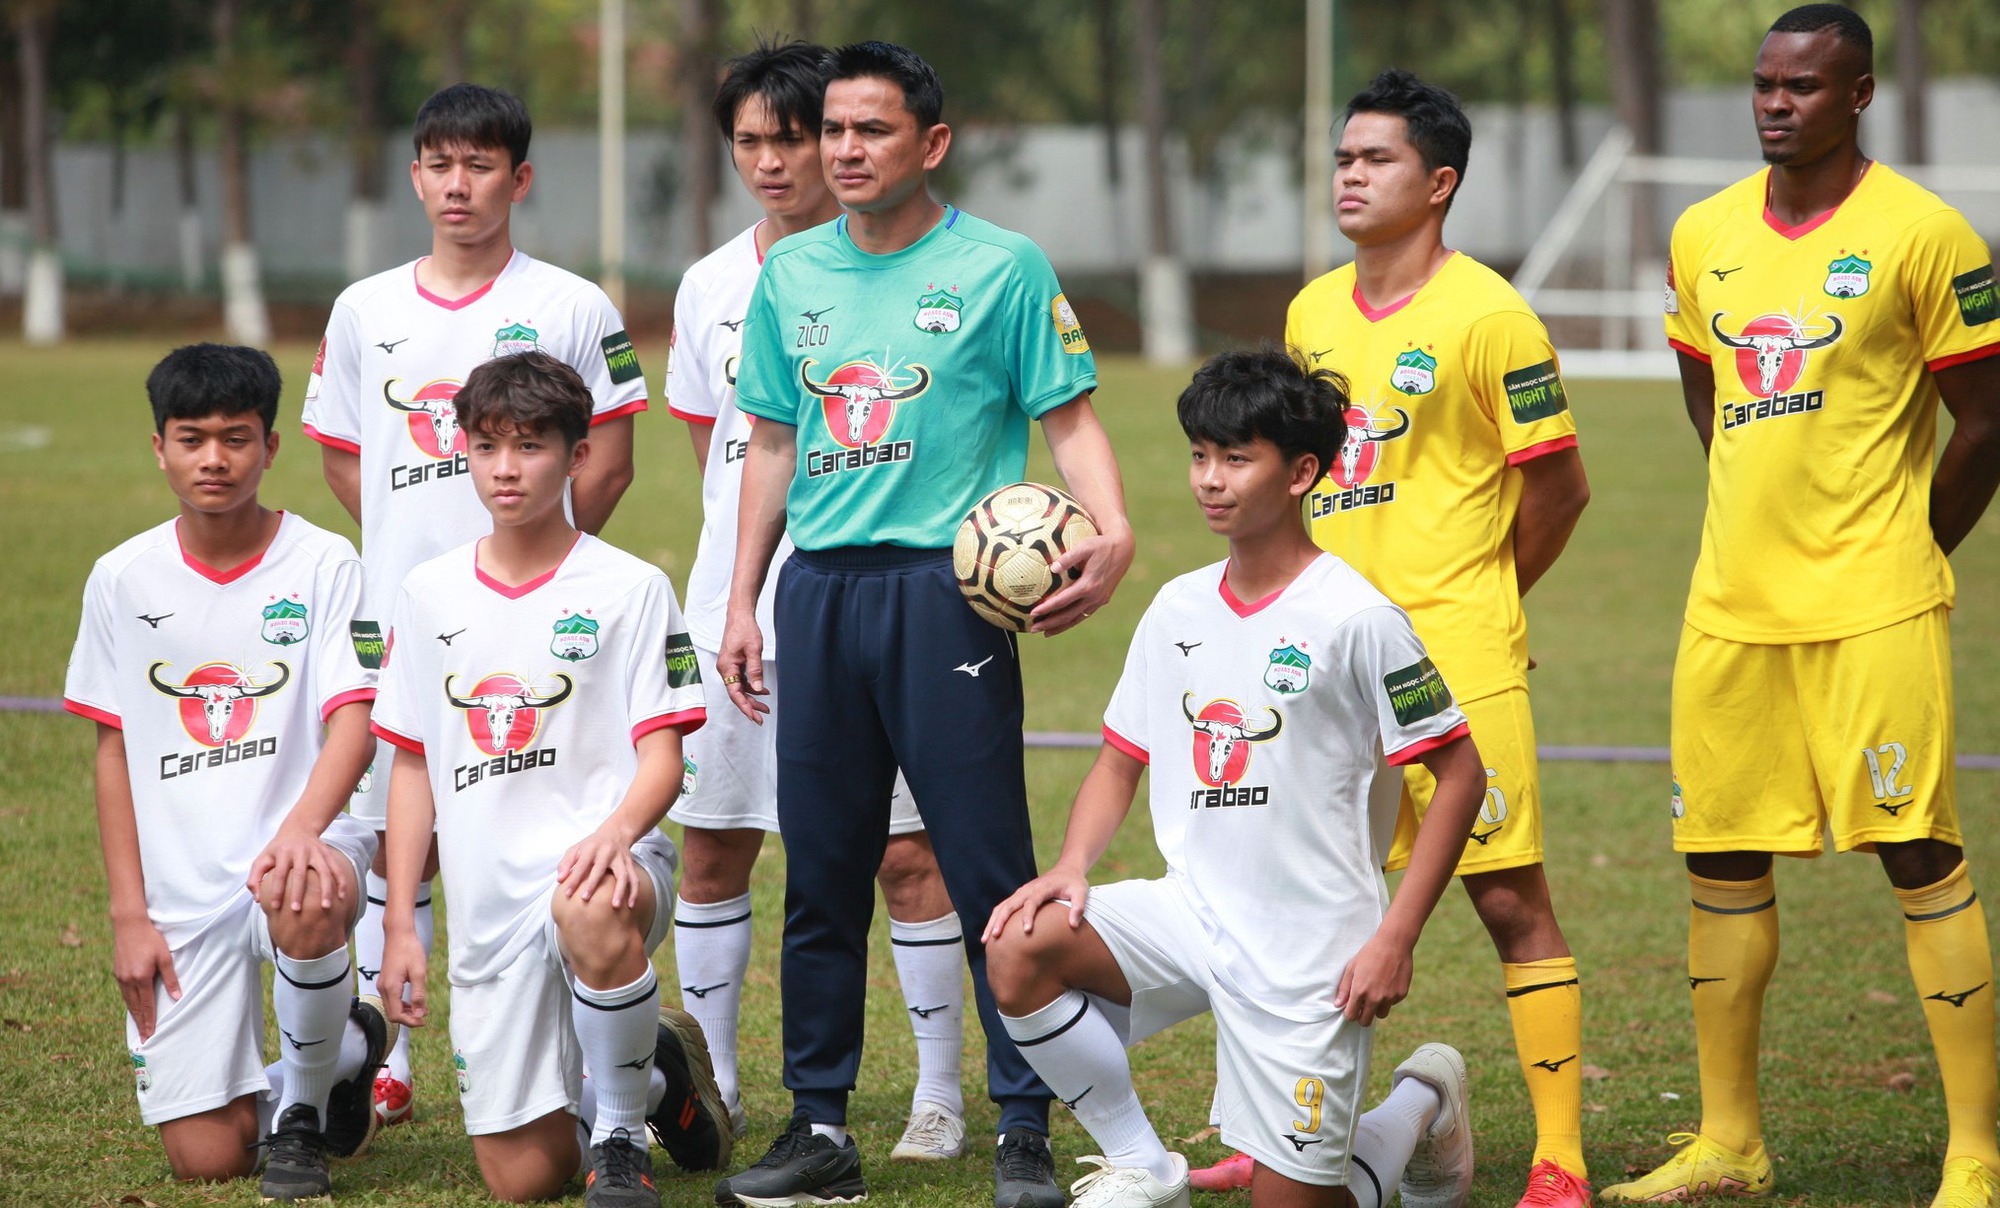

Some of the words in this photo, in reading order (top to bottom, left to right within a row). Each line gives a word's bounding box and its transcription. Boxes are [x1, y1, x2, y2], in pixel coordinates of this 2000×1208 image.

[1961, 288, 1994, 312] NIGHT
[797, 324, 829, 348] ZICO
[608, 348, 637, 372] NIGHT
[1510, 385, 1547, 410] NIGHT
[1723, 390, 1824, 430] Carabao
[391, 452, 470, 492] Carab
[807, 441, 912, 477] Carabao
[1311, 482, 1395, 519] Carabao
[354, 640, 385, 657] NIGHT
[667, 654, 697, 673] NIGHT
[1392, 685, 1430, 712] NIGHT
[160, 736, 277, 780] Carabao
[454, 748, 556, 792] Carabao
[1861, 742, 1913, 799] 12
[1190, 782, 1269, 810] rabao
[1293, 1076, 1325, 1134] 9
